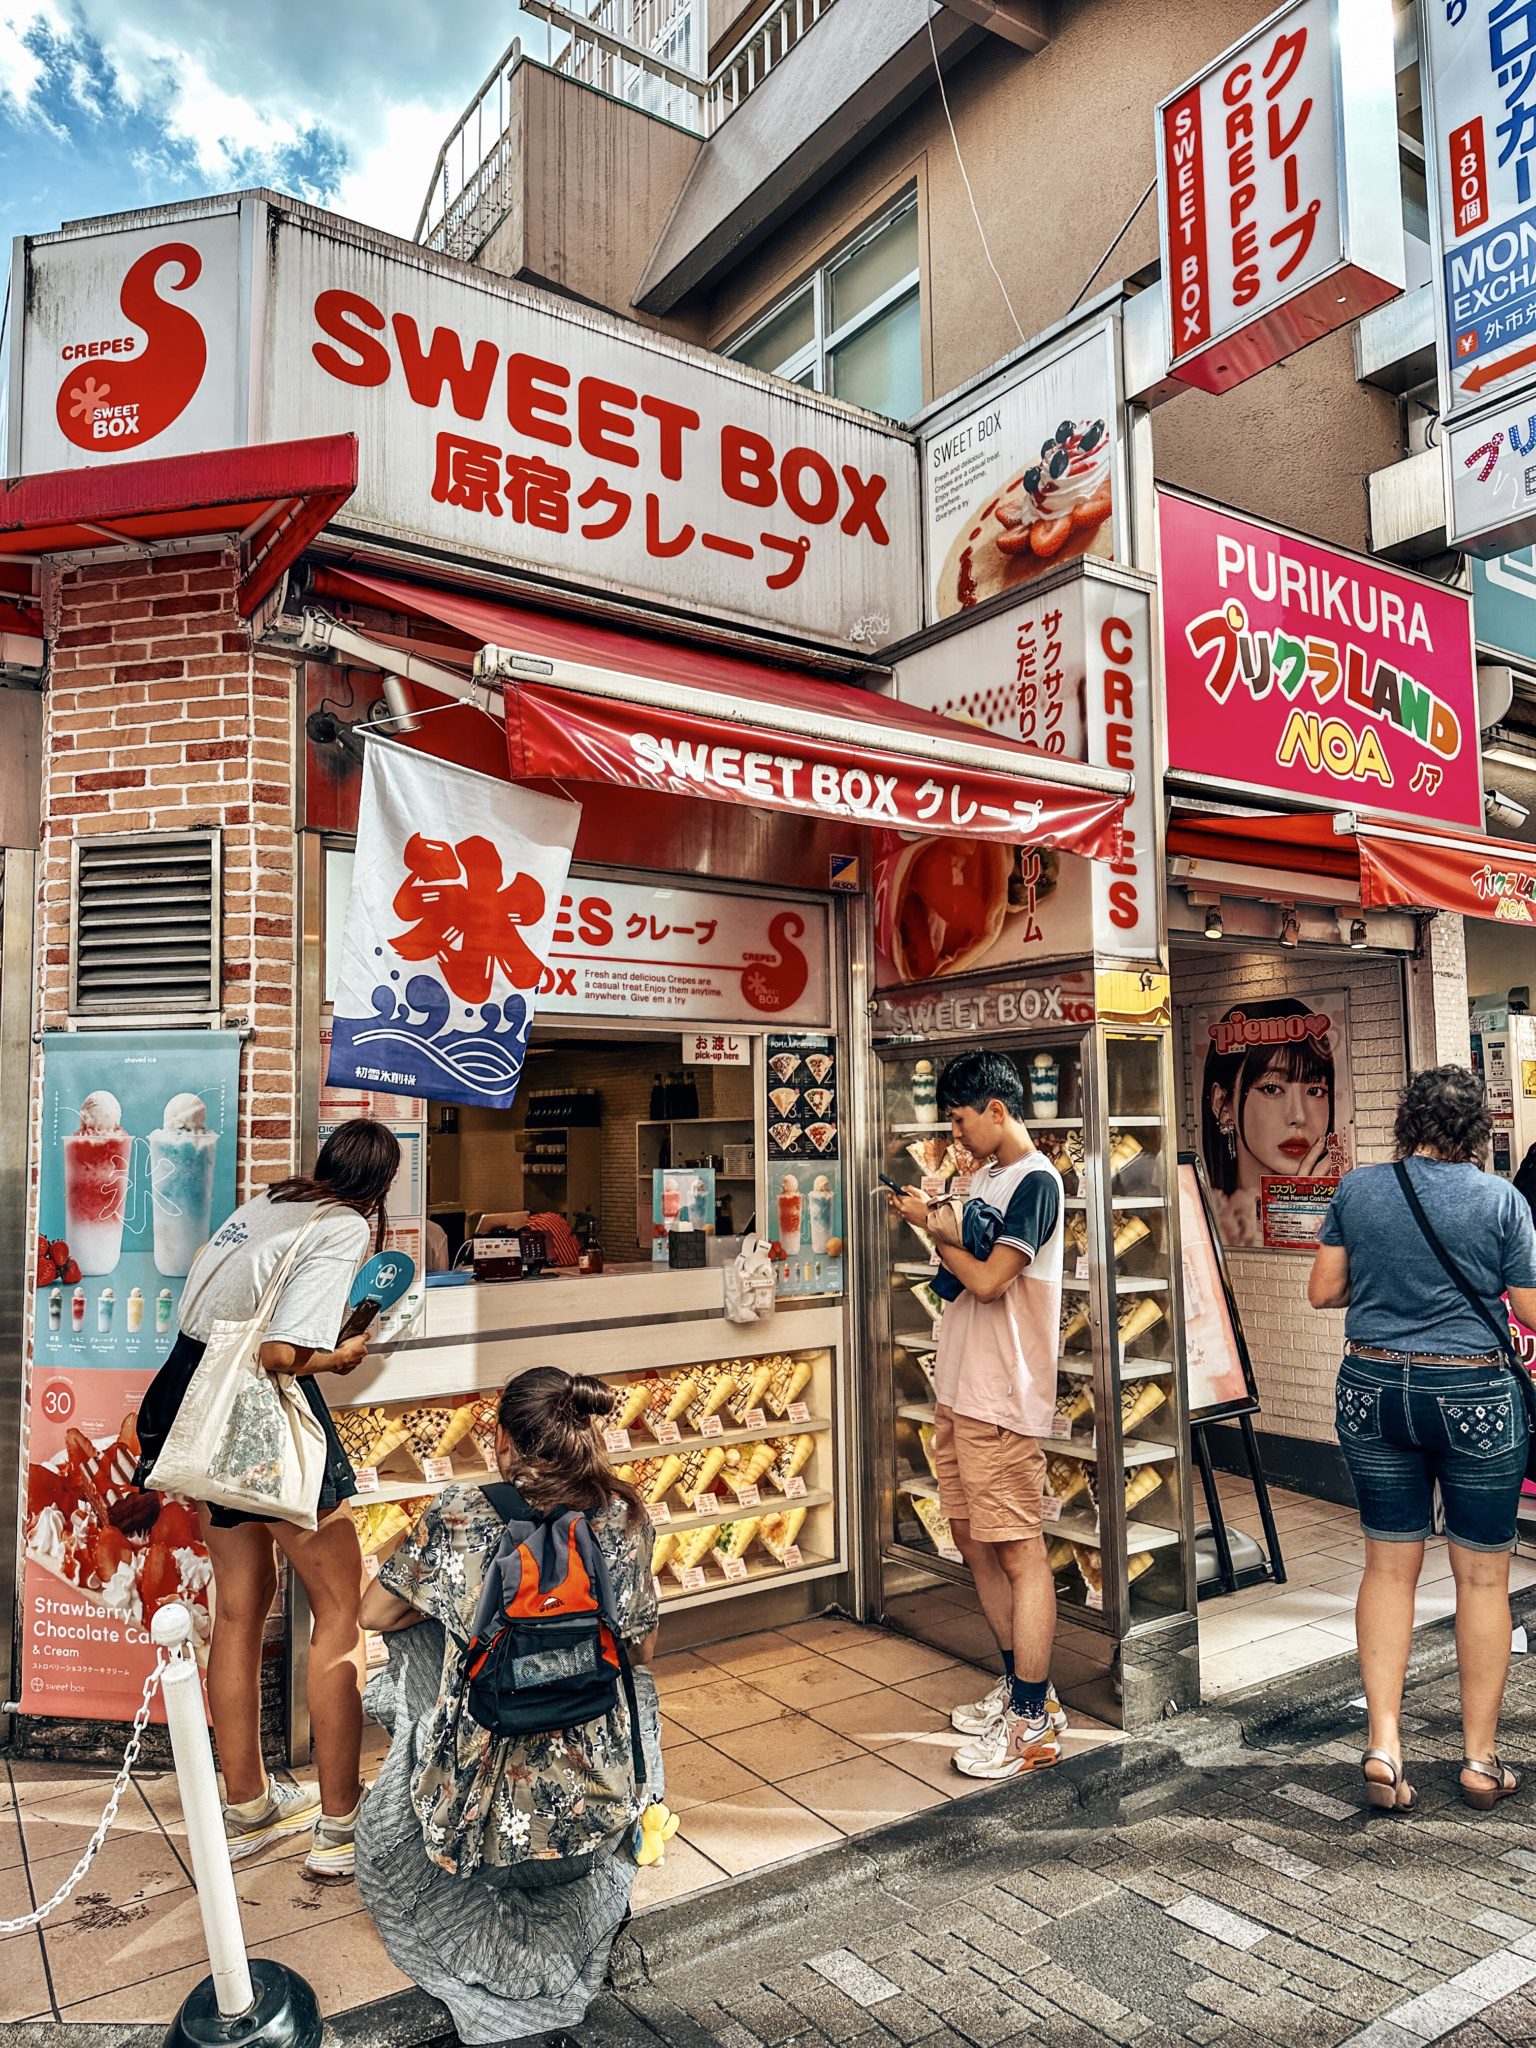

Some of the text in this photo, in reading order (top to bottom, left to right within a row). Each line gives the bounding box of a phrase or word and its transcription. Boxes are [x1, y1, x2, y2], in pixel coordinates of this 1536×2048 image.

[1489, 0, 1536, 203] ロッカー
[1263, 26, 1322, 283] クレープ
[1222, 62, 1261, 308] CREPES
[1459, 129, 1481, 227] 180個
[1172, 107, 1201, 342] SWEET BOX
[61, 337, 135, 361] CREPES
[93, 404, 139, 420] SWEET
[93, 415, 140, 439] BOX
[312, 289, 890, 546] SWEET BOX
[933, 410, 1002, 468] SWEET BOX
[431, 431, 810, 590] 原宿クレープ
[1216, 534, 1434, 652] PURIKURA
[1017, 621, 1038, 748] こだわり
[1042, 609, 1066, 755] サクサクの
[1276, 709, 1394, 787] NOA
[629, 733, 1045, 834] SWEET BOX クレープ
[1100, 616, 1139, 930] CREES
[1409, 761, 1443, 796] ノア
[832, 881, 857, 890] ALSOK
[1471, 864, 1536, 904] プリクラLA
[387, 831, 547, 1005] 氷
[1495, 897, 1533, 922] NOA
[626, 913, 717, 944] クレープ
[742, 952, 777, 963] CREPES
[585, 969, 609, 979] Fresh
[612, 972, 627, 980] and
[630, 973, 665, 984] delicious
[667, 975, 696, 985] Crepes
[592, 981, 620, 990] casual
[669, 986, 688, 995] them
[674, 996, 686, 1005] try
[892, 985, 1064, 1035] SWEET BOX
[695, 1035, 739, 1051] お渡し
[1208, 1012, 1305, 1054] piemo
[695, 1051, 739, 1060] pick-up here
[1269, 1184, 1338, 1195] コスプレ無料レンタ
[45, 1391, 71, 1414] 30
[34, 1597, 132, 1625] Strawberry
[33, 1620, 161, 1645] Chocolate Ca
[32, 1644, 80, 1657] & Cream
[45, 1681, 86, 1693] sweet box
